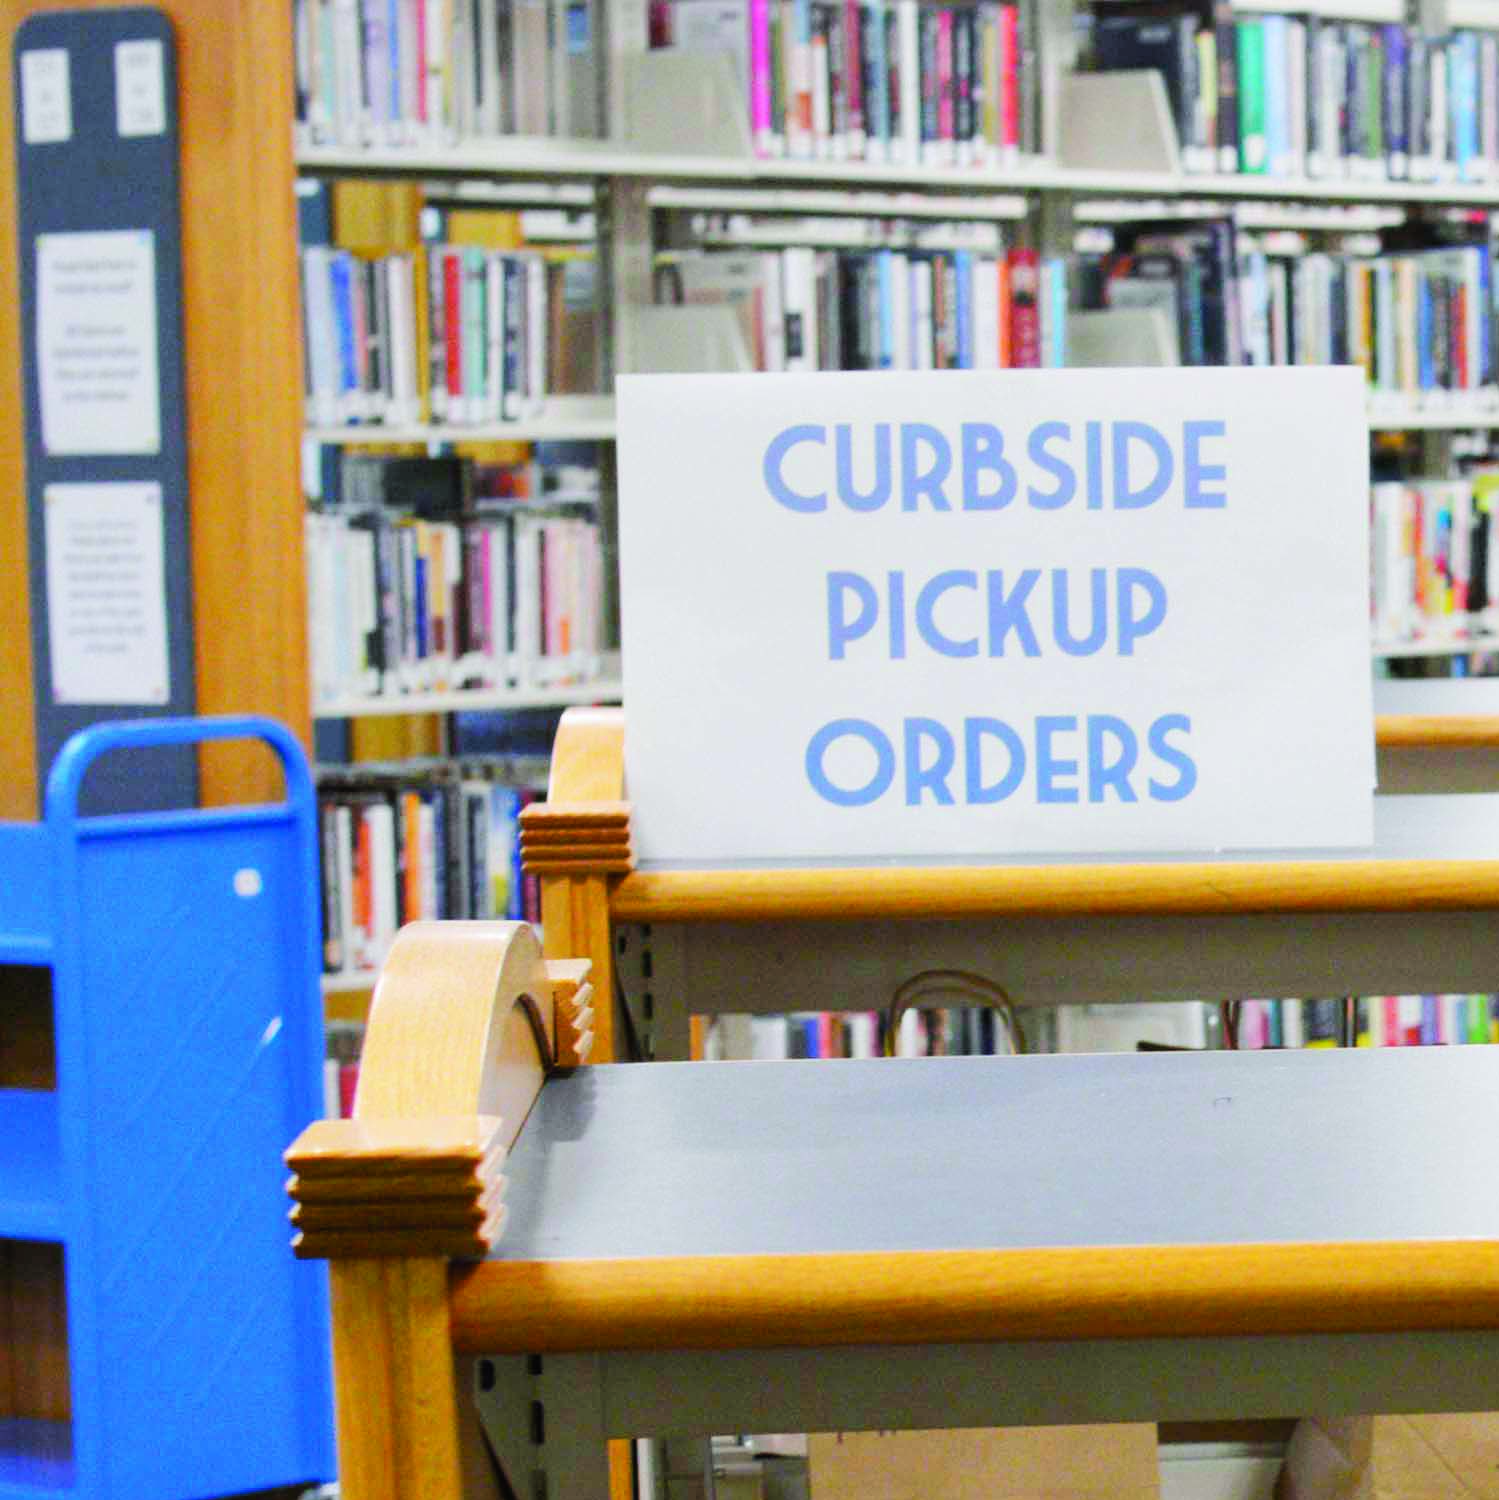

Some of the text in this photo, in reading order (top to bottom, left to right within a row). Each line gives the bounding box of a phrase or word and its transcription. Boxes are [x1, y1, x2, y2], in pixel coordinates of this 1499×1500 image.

[763, 421, 1227, 514] CURBSIDE
[826, 567, 1168, 661] PICKUP
[805, 713, 1198, 808] ORDERS
